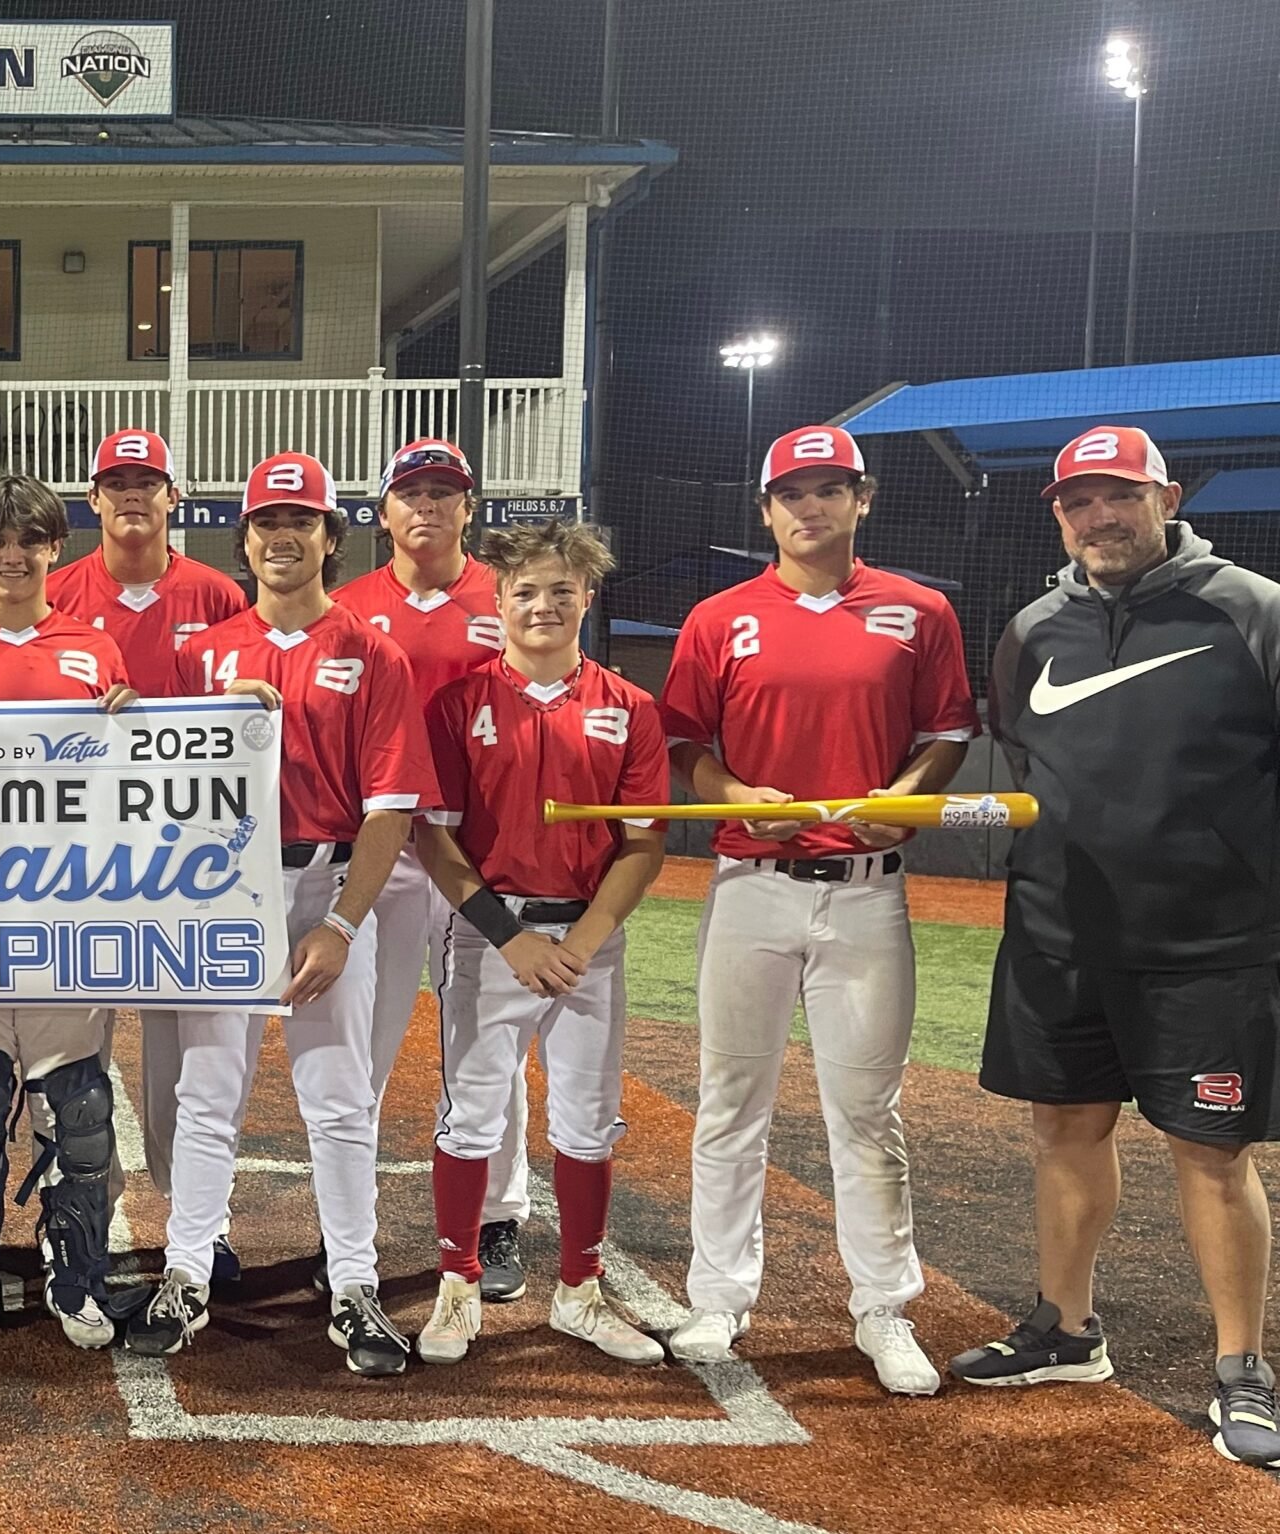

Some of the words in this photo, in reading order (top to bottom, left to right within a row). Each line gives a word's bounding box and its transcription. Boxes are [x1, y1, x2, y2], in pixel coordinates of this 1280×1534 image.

[62, 55, 149, 77] NATION
[508, 500, 538, 512] FIELDS
[731, 613, 761, 659] 2
[202, 648, 239, 693] 14
[471, 704, 497, 746] 4
[13, 746, 36, 760] BY
[28, 732, 110, 763] Victus
[131, 727, 234, 762] 2023
[120, 776, 250, 823] RUN
[944, 811, 977, 820] HOME
[983, 811, 1007, 820] RUN
[1193, 1101, 1228, 1111] BALANCE
